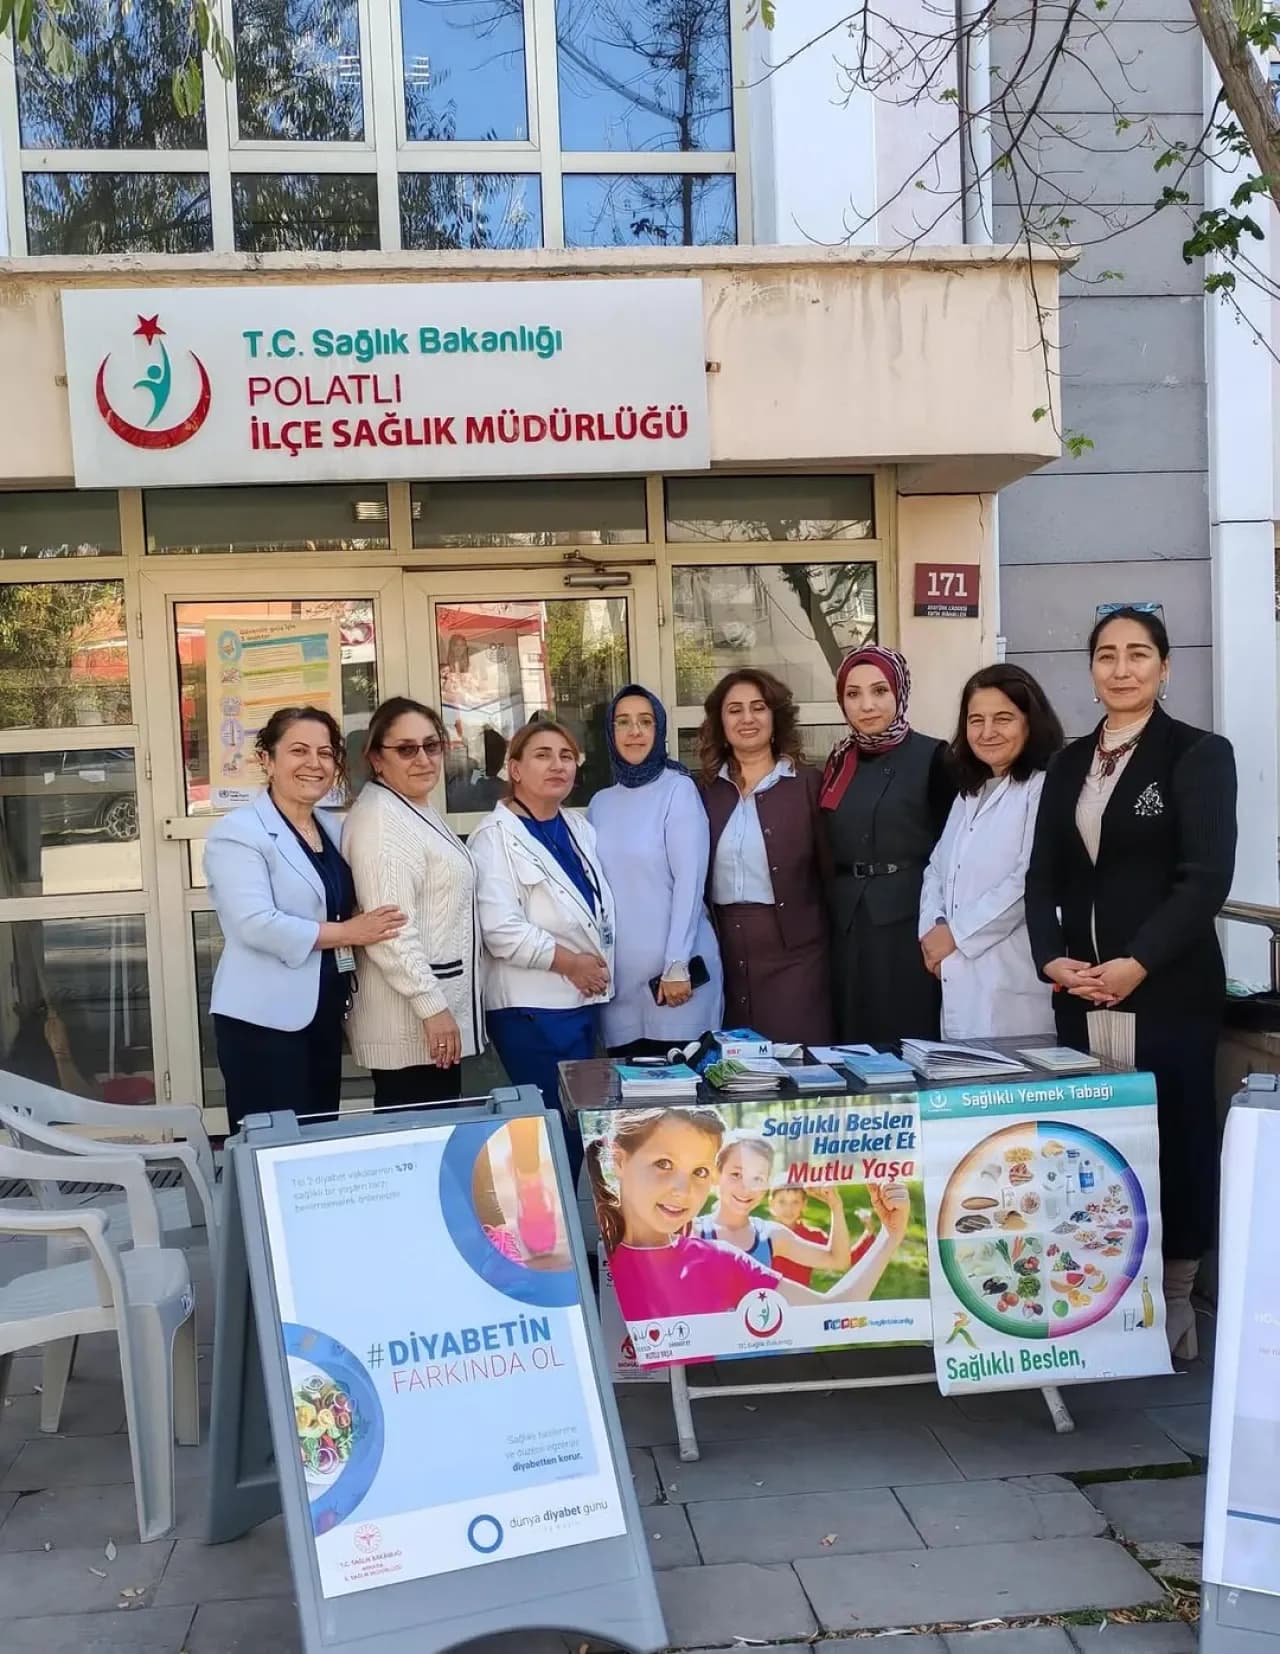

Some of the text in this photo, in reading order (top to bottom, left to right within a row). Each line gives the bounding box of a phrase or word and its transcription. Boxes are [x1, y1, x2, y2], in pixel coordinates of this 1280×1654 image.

[242, 325, 563, 363] T.C. Sağlık Bakanlığı
[248, 374, 402, 406] POLATLI
[250, 404, 688, 457] İLÇE SAĞLIK MÜDÜRLÜĞÜ
[927, 571, 968, 597] 171
[961, 1082, 1114, 1109] Sağlıklı Yemek Tabağı
[762, 1111, 914, 1140] Sağlıklı Beslen
[813, 1131, 917, 1155] Hareket Et
[787, 1157, 915, 1185] Mutlu Yaşa
[392, 1345, 566, 1395] FARKINDA OL
[946, 1345, 1086, 1382] Sağlıklı Beslen,
[512, 1456, 557, 1472] diyabetten
[543, 1505, 582, 1522] diyabet
